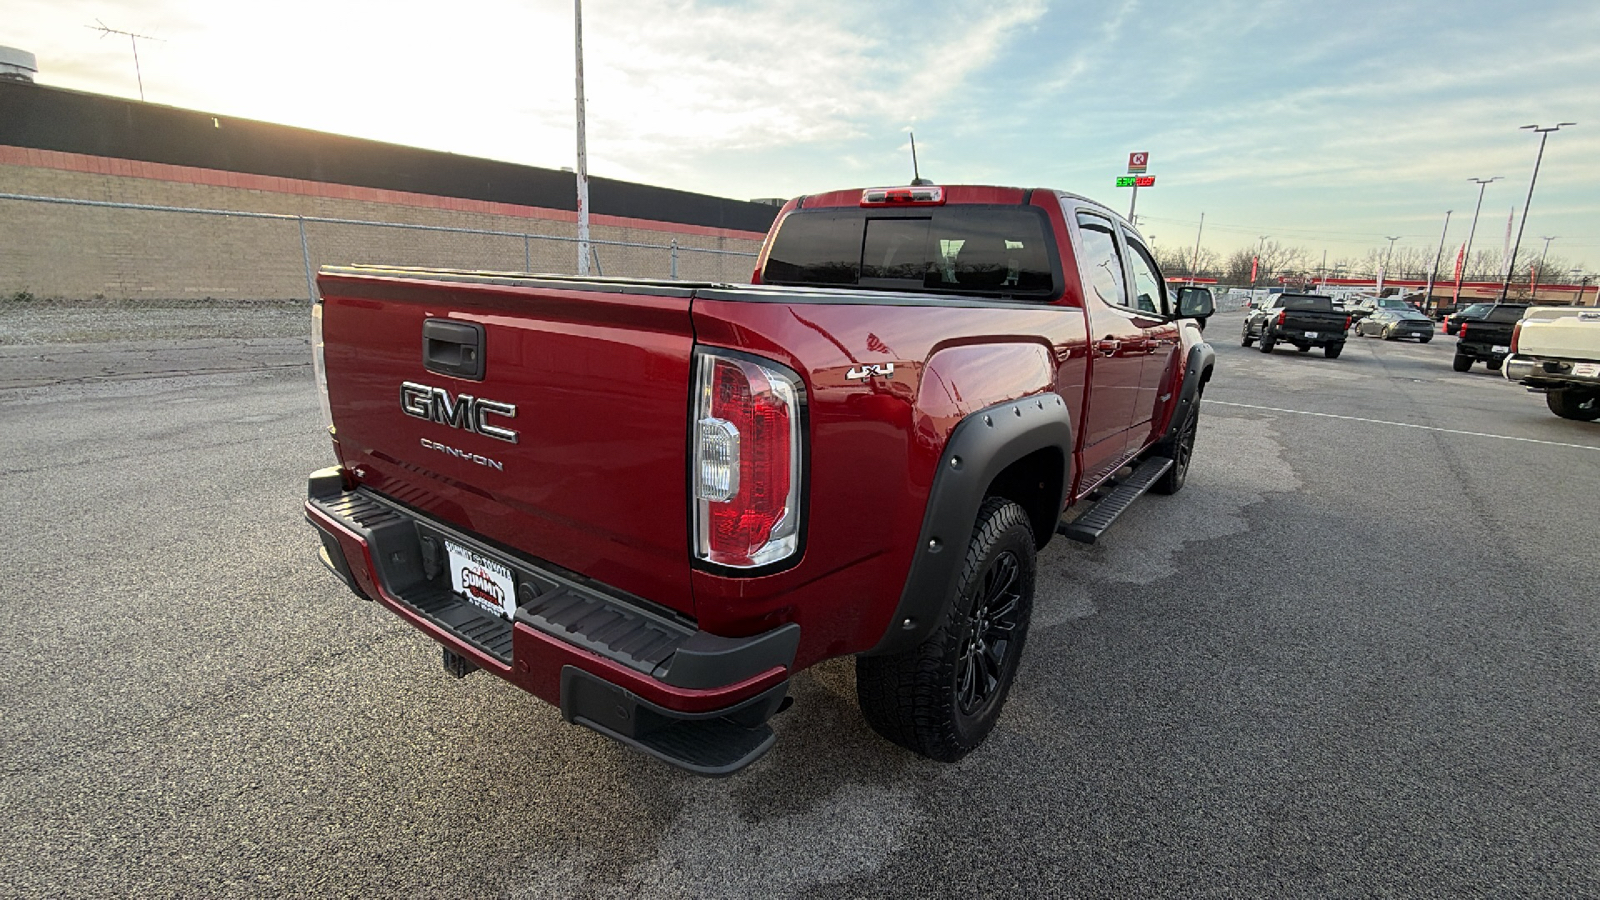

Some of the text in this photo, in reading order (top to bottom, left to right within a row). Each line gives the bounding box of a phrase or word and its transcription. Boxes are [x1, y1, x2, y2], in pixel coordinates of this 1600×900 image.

[400, 381, 519, 444] GMC
[420, 437, 504, 472] CANYON
[463, 569, 505, 607] SUMMIT
